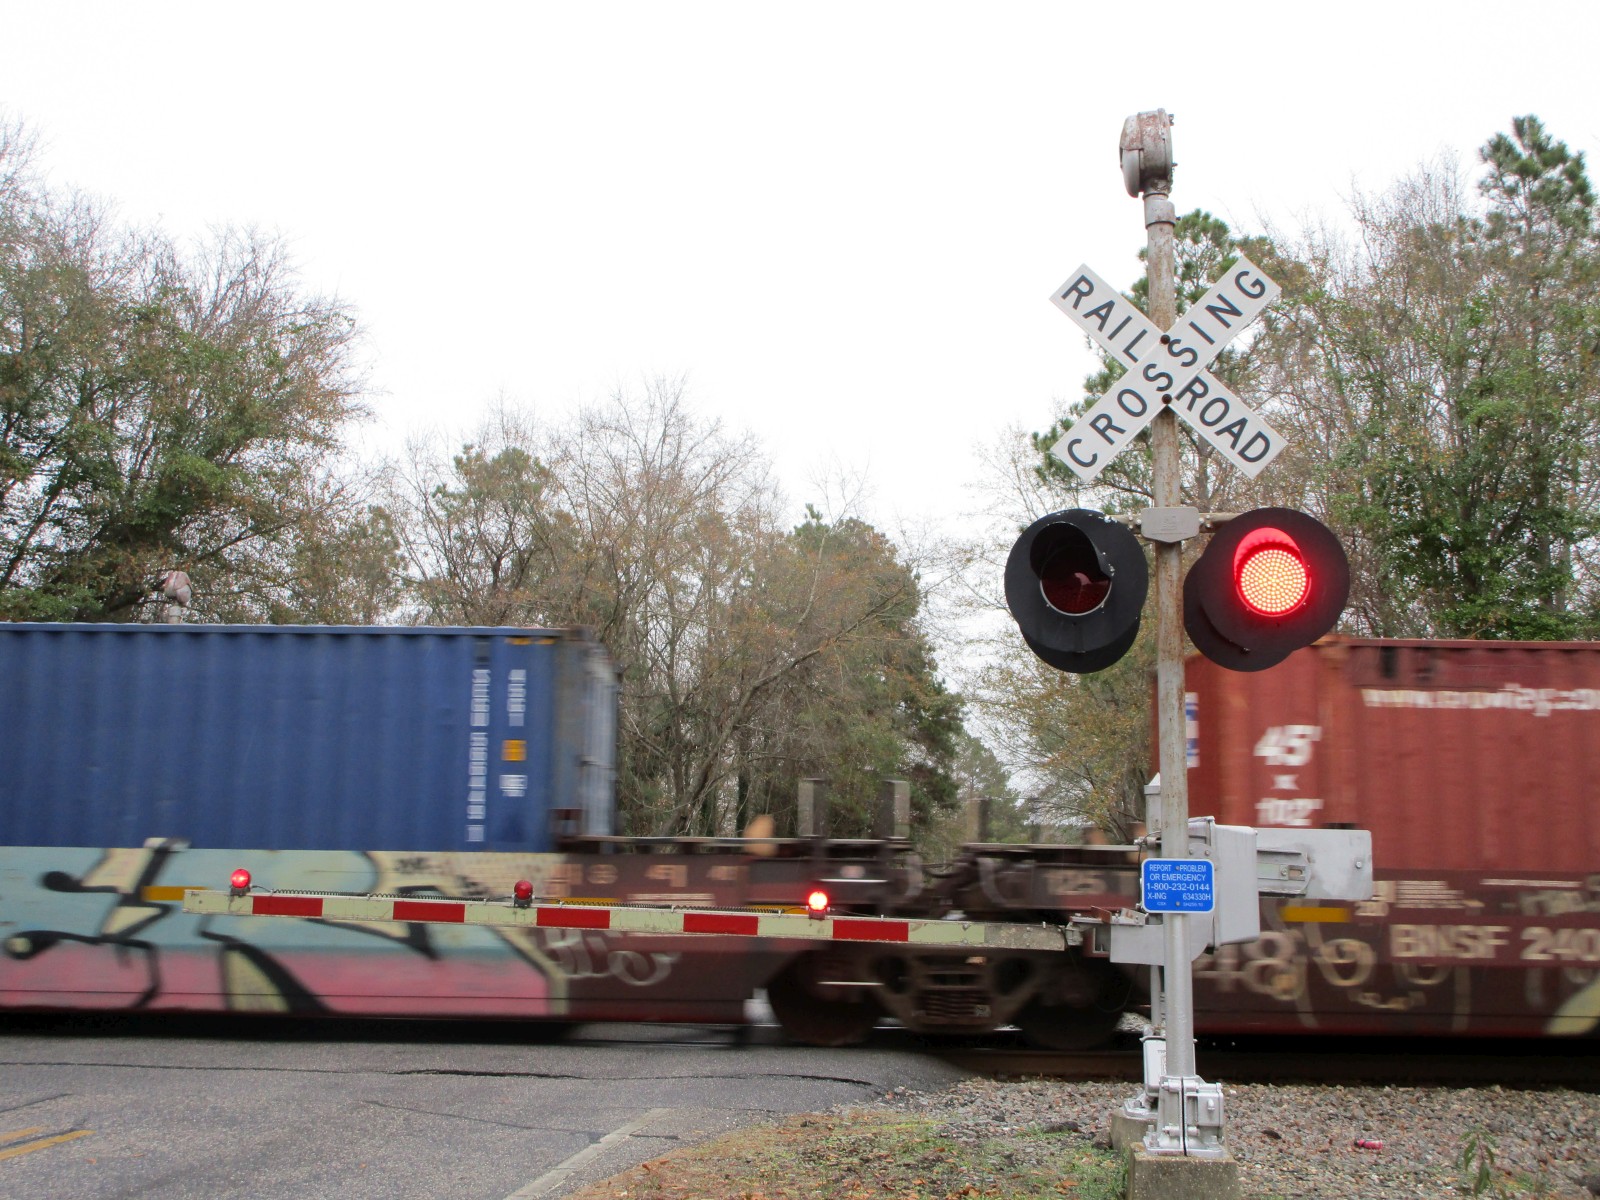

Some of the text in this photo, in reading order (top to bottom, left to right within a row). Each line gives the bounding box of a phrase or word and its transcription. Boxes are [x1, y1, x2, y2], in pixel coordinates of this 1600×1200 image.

[1061, 274, 1271, 463] RAIL ROAD
[1067, 270, 1266, 468] CROSSING
[1149, 864, 1206, 872] REPORT PROBLEM
[1150, 873, 1206, 881] OR EMERGENCY
[1146, 882, 1210, 891] 1-800-232-0144
[1147, 892, 1211, 901] X-ING 634330H
[1390, 924, 1509, 959] BNSF
